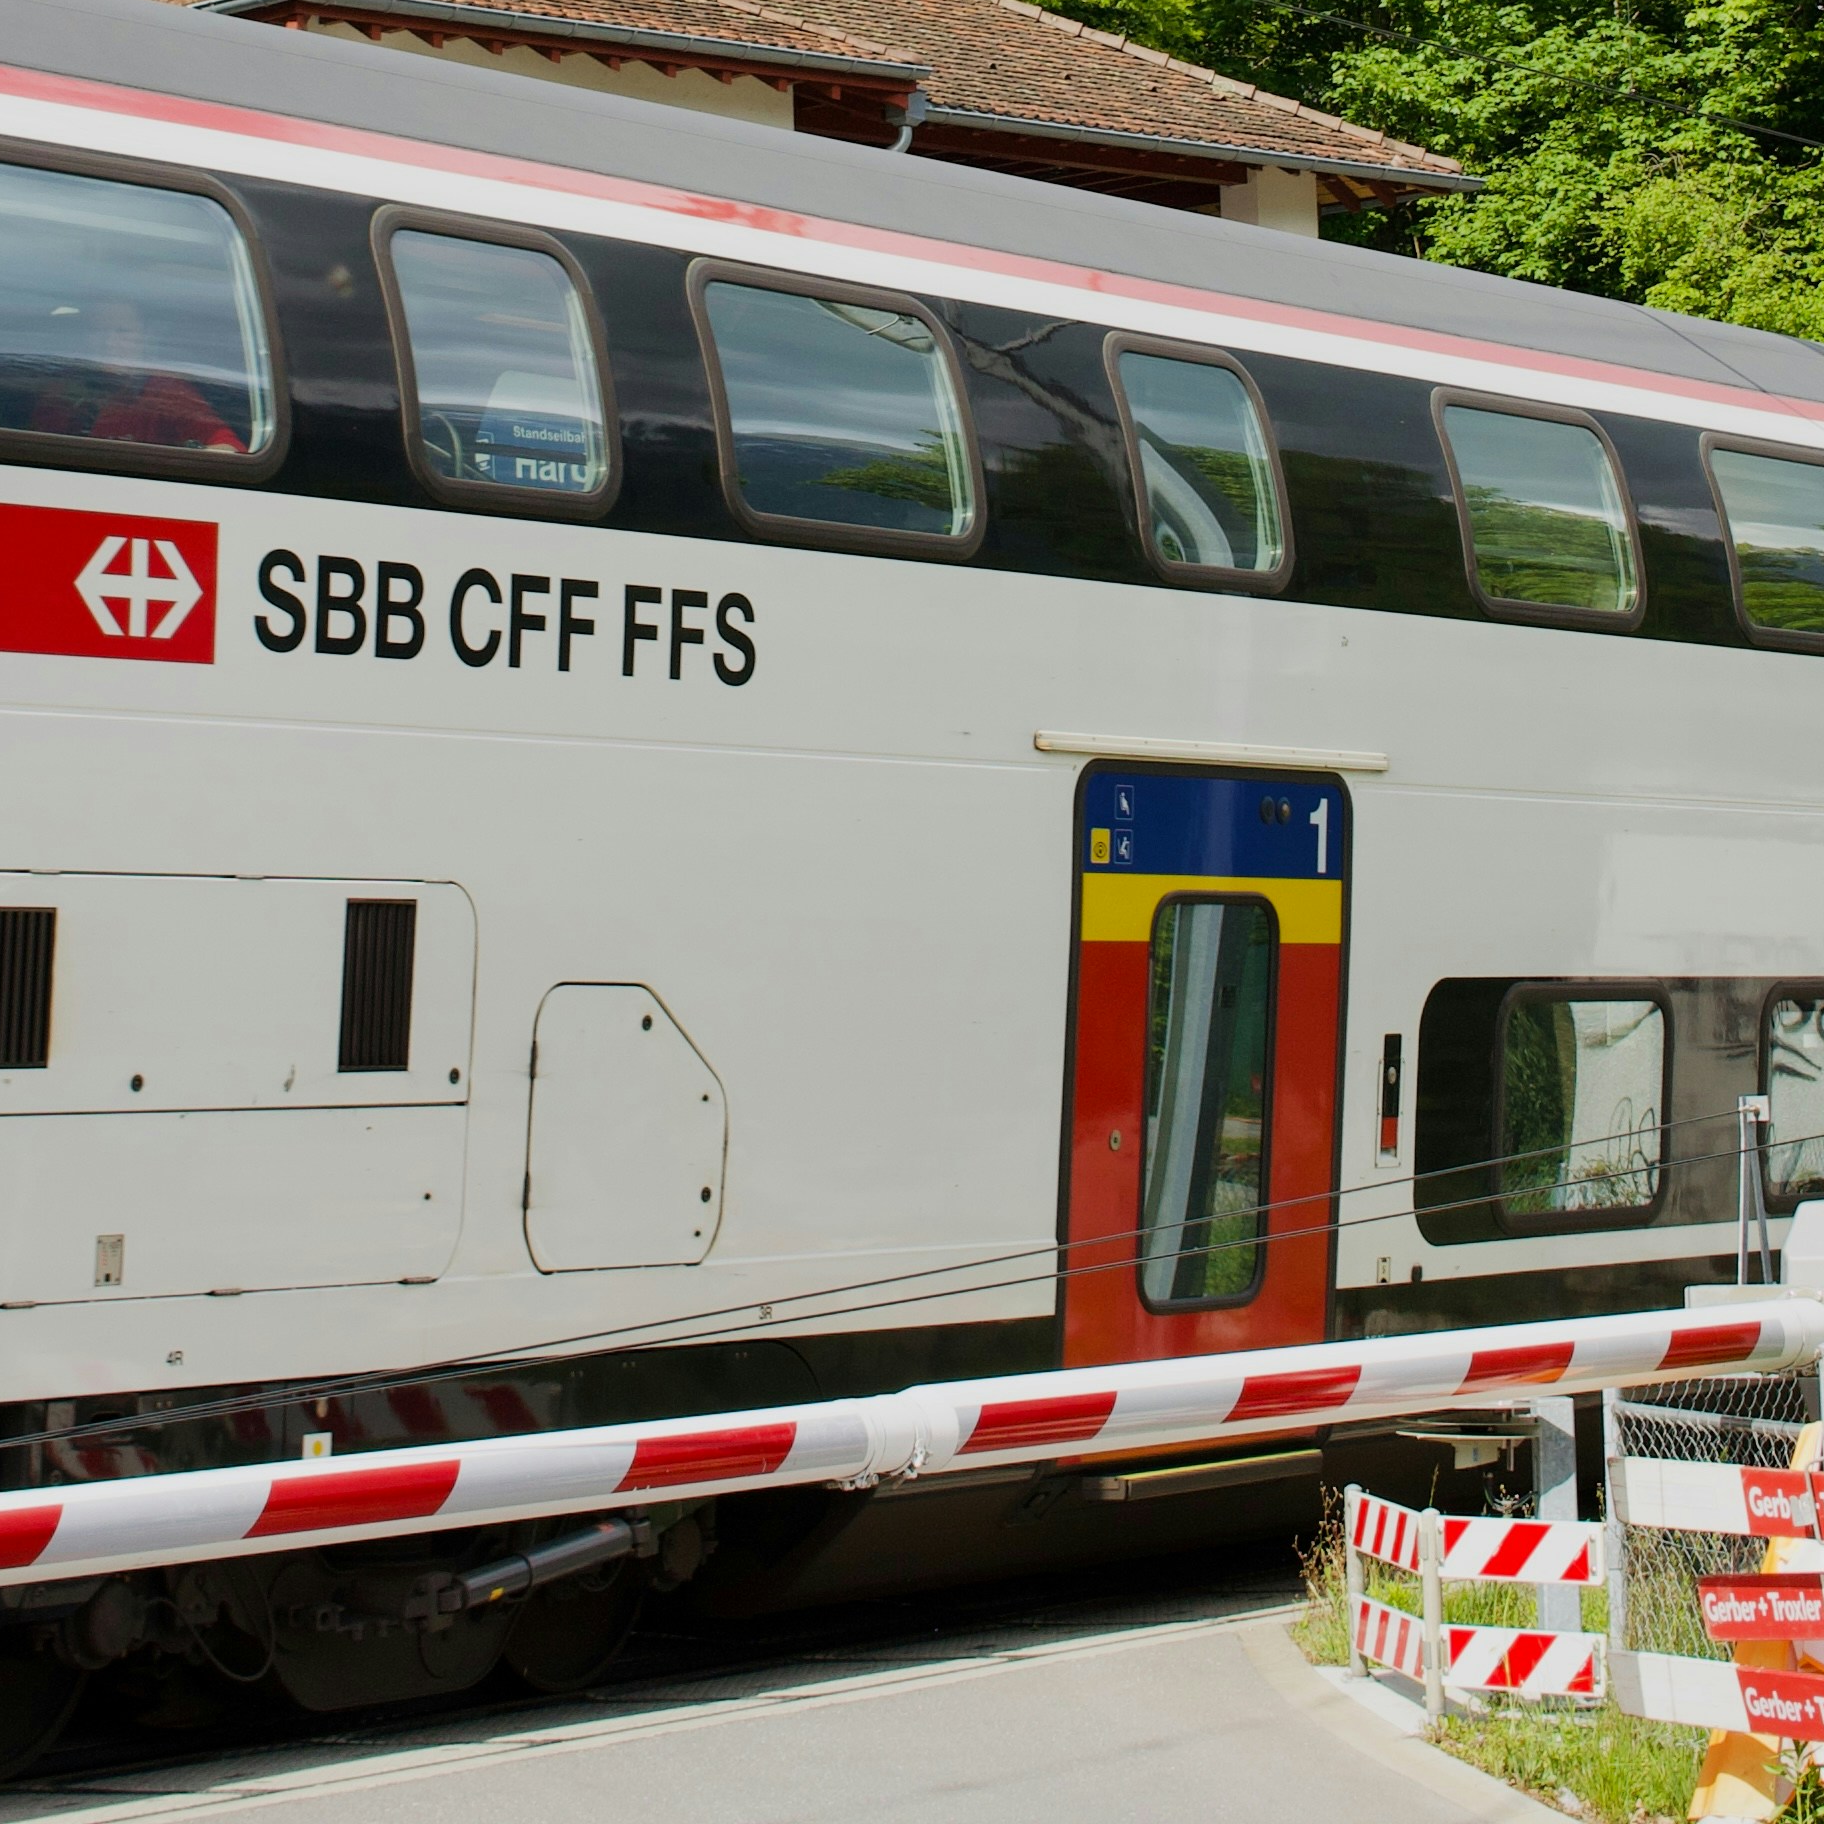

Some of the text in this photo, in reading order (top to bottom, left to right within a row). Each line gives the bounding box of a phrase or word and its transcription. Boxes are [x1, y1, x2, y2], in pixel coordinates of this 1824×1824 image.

[254, 548, 757, 687] SBB CFF FFS
[1309, 797, 1328, 873] 1
[1748, 1486, 1792, 1520] Gerb
[1704, 1591, 1756, 1622] Gerber
[1766, 1591, 1822, 1622] Troxler
[1744, 1686, 1803, 1722] Gerber
